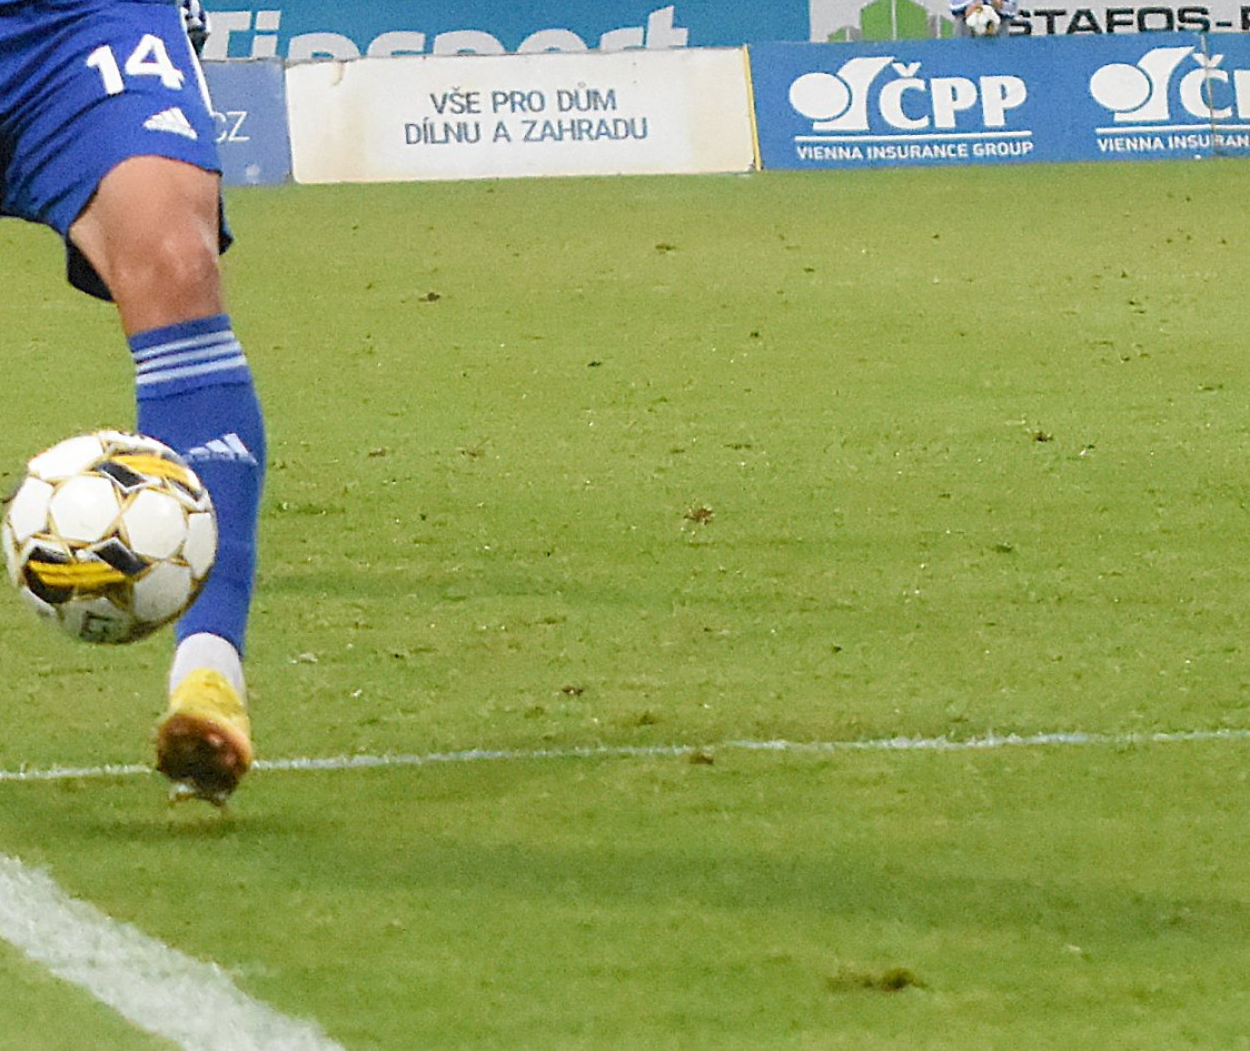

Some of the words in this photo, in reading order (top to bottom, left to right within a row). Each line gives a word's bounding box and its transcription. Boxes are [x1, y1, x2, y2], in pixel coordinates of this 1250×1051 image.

[1009, 5, 1250, 38] STAFOS-
[86, 33, 186, 96] 14
[429, 86, 481, 115] VŠE
[492, 89, 546, 113] PRO
[558, 80, 617, 112] DŮM
[878, 61, 1028, 131] ČPP
[404, 116, 481, 145] DÍLNU
[493, 120, 512, 142] A
[522, 117, 648, 142] ZAHRADU
[1097, 136, 1165, 152] VIENNA
[796, 146, 863, 160] VIENNA
[867, 143, 968, 159] INSURANCE
[972, 141, 1034, 156] GROUP
